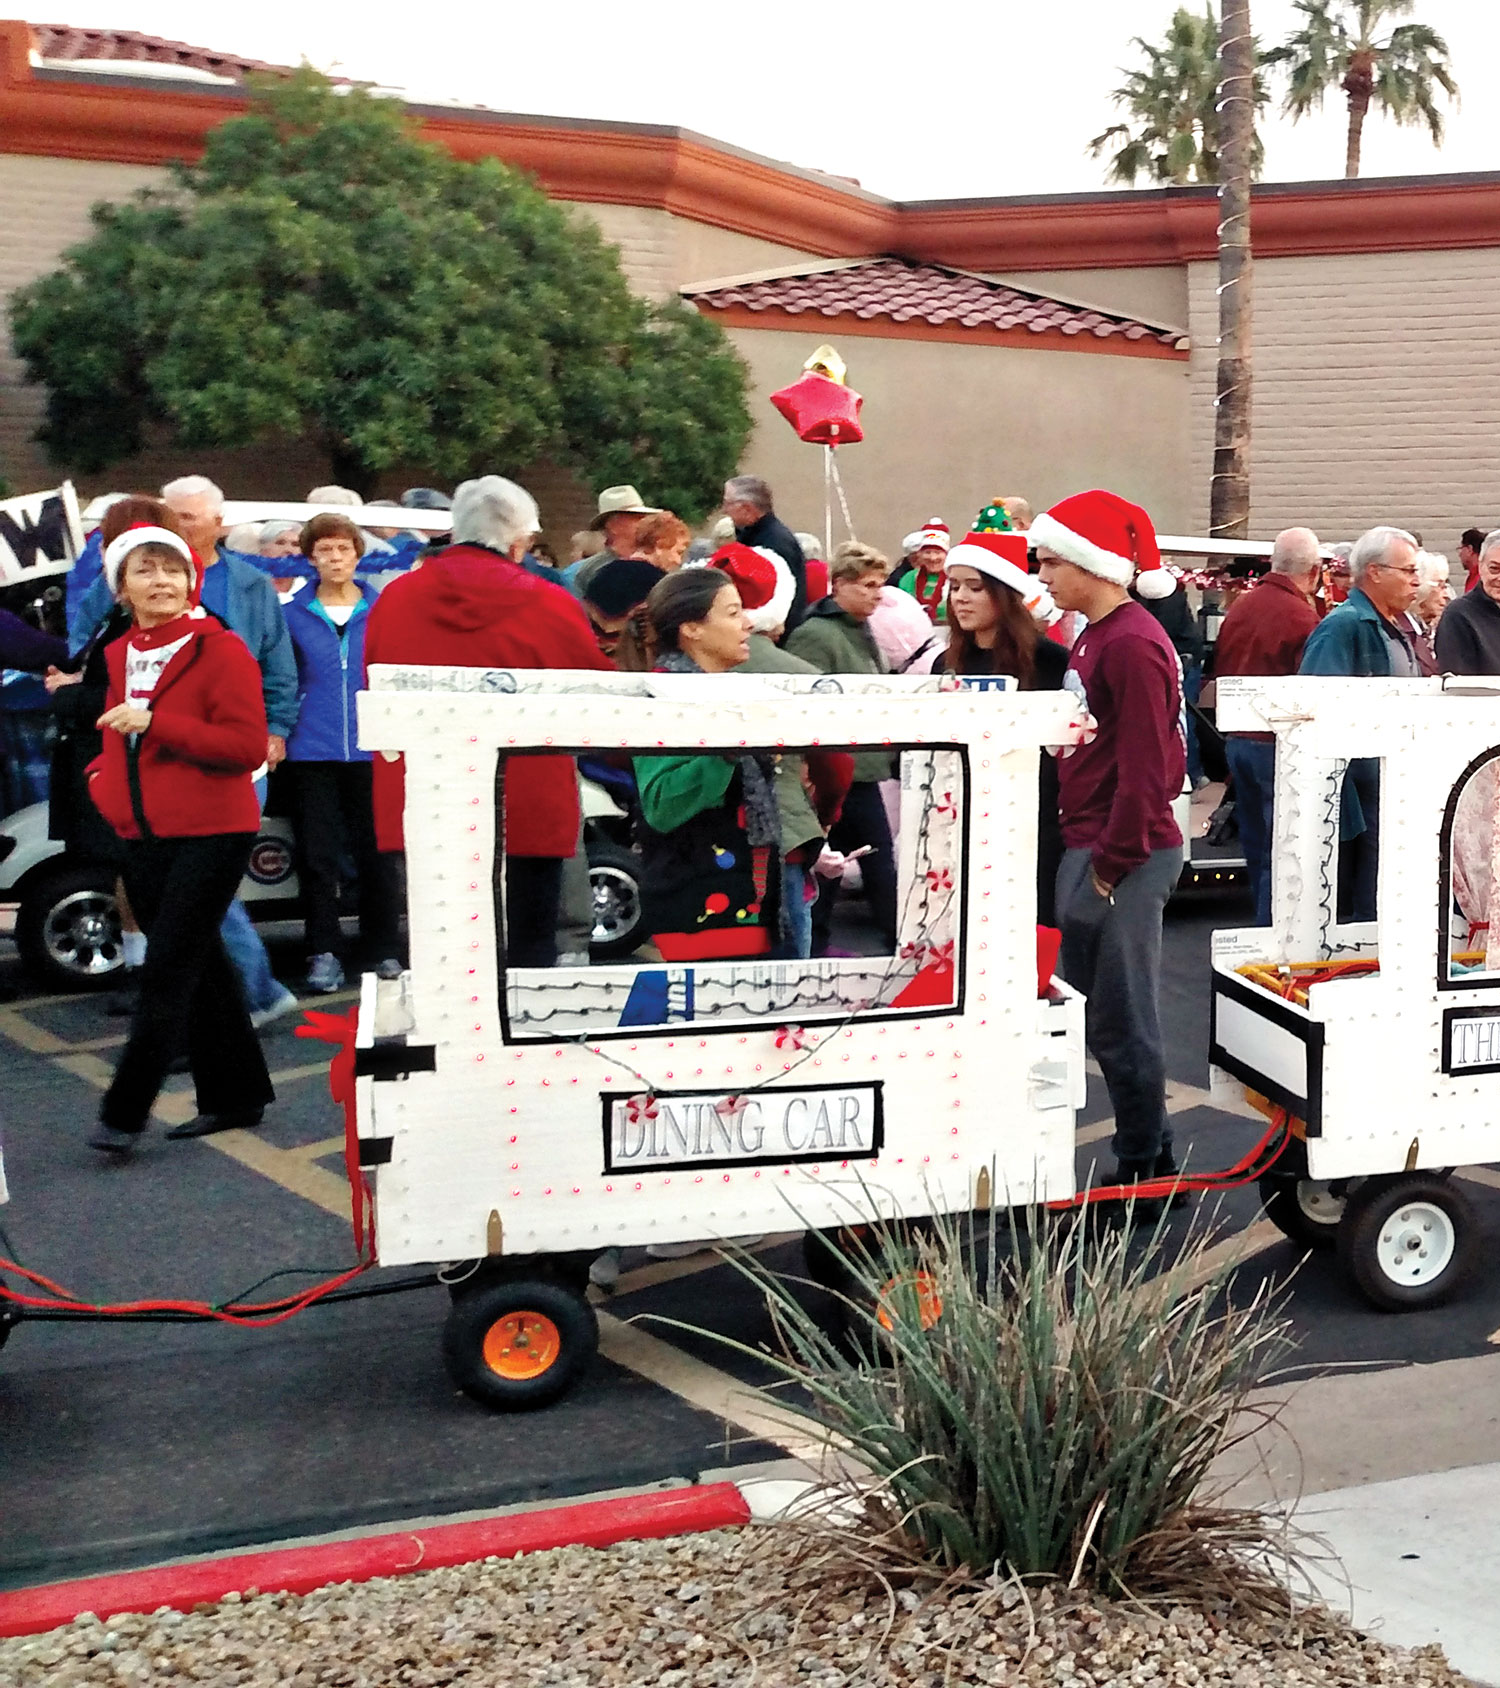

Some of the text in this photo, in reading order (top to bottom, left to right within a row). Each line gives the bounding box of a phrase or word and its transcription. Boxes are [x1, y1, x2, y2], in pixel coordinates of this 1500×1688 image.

[0, 496, 66, 569] W
[617, 1096, 864, 1159] DINING CAR
